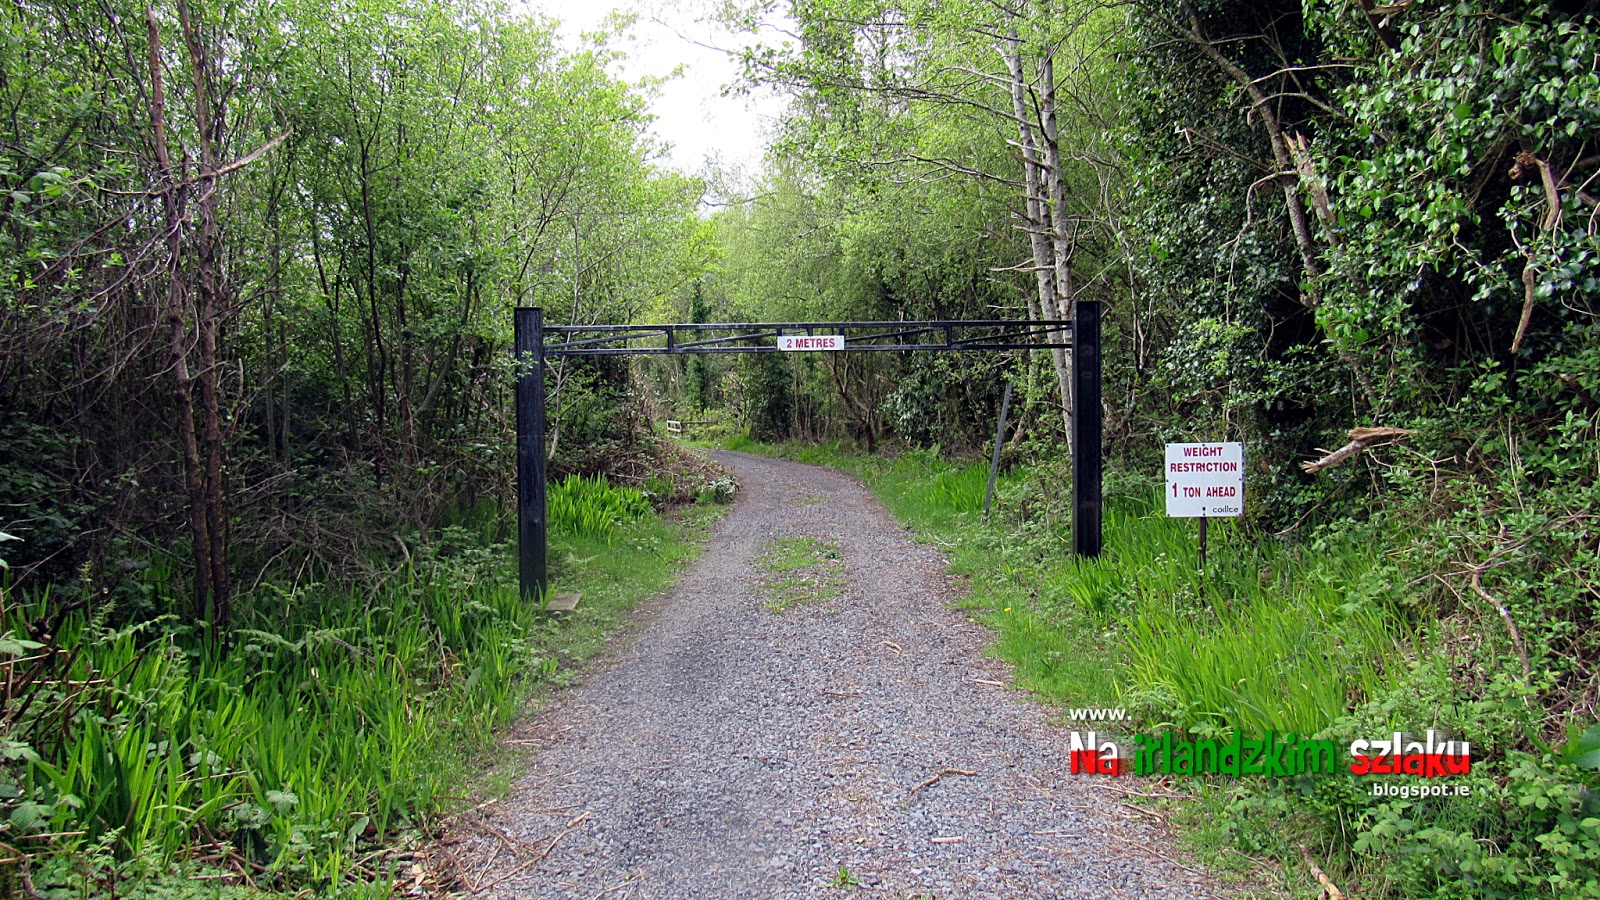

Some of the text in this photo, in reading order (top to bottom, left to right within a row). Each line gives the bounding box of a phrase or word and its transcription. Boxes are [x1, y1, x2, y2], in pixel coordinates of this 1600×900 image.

[786, 338, 835, 348] 2 METRES
[1183, 447, 1223, 457] WEIGHT
[1170, 462, 1237, 472] RESTRICTION
[1172, 482, 1236, 497] 1 TON AHEAD
